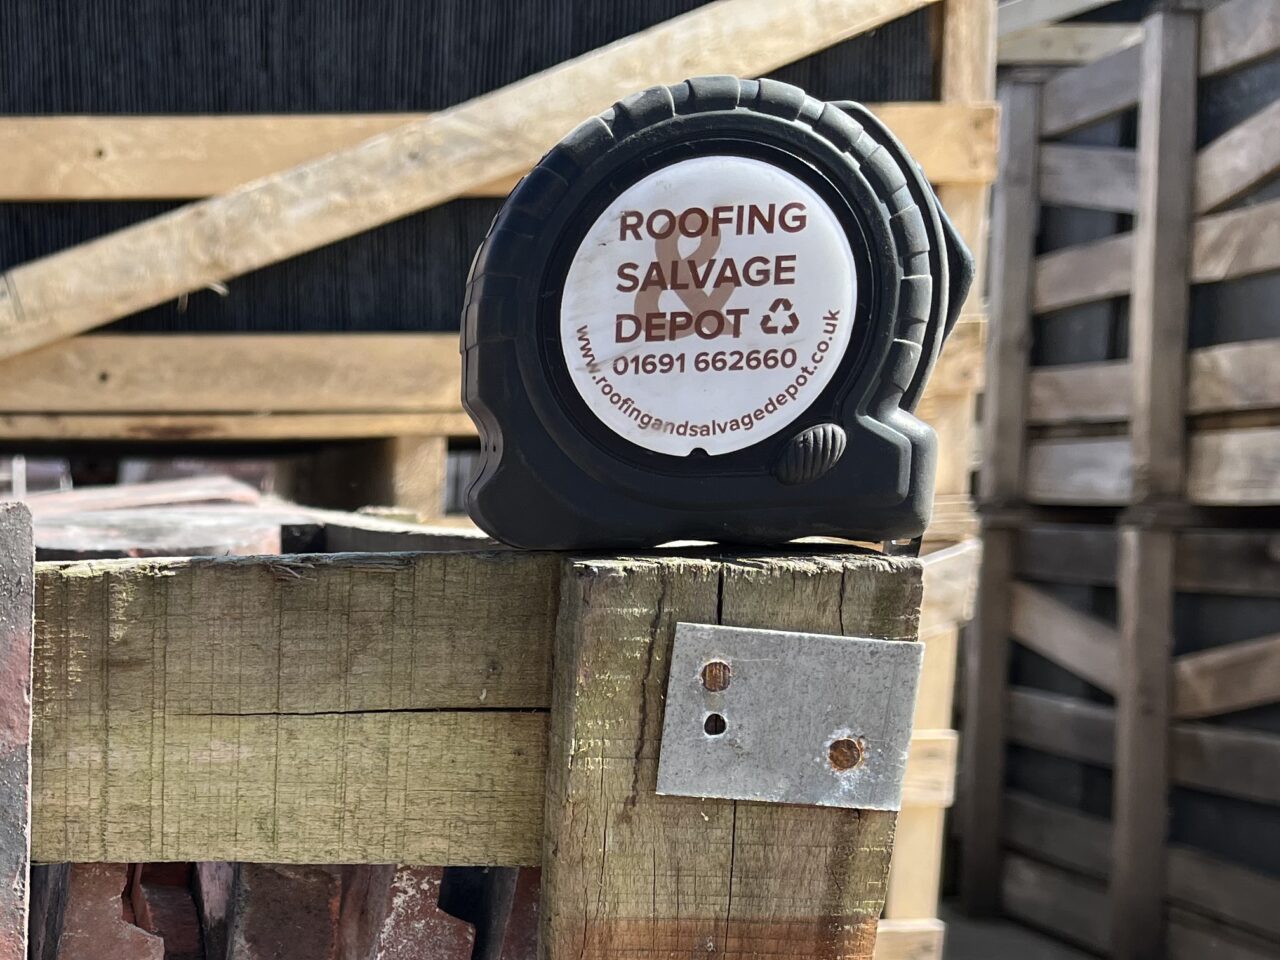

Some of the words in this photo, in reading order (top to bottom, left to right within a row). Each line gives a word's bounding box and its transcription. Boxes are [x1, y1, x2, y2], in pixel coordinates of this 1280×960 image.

[620, 202, 807, 241] ROOFING
[616, 255, 797, 293] SALVAGE
[615, 308, 750, 343] DEPOT
[575, 308, 841, 437] www.roofingandsalvagedepot.co.uk
[613, 353, 686, 376] 01691
[694, 348, 797, 372] 662660
